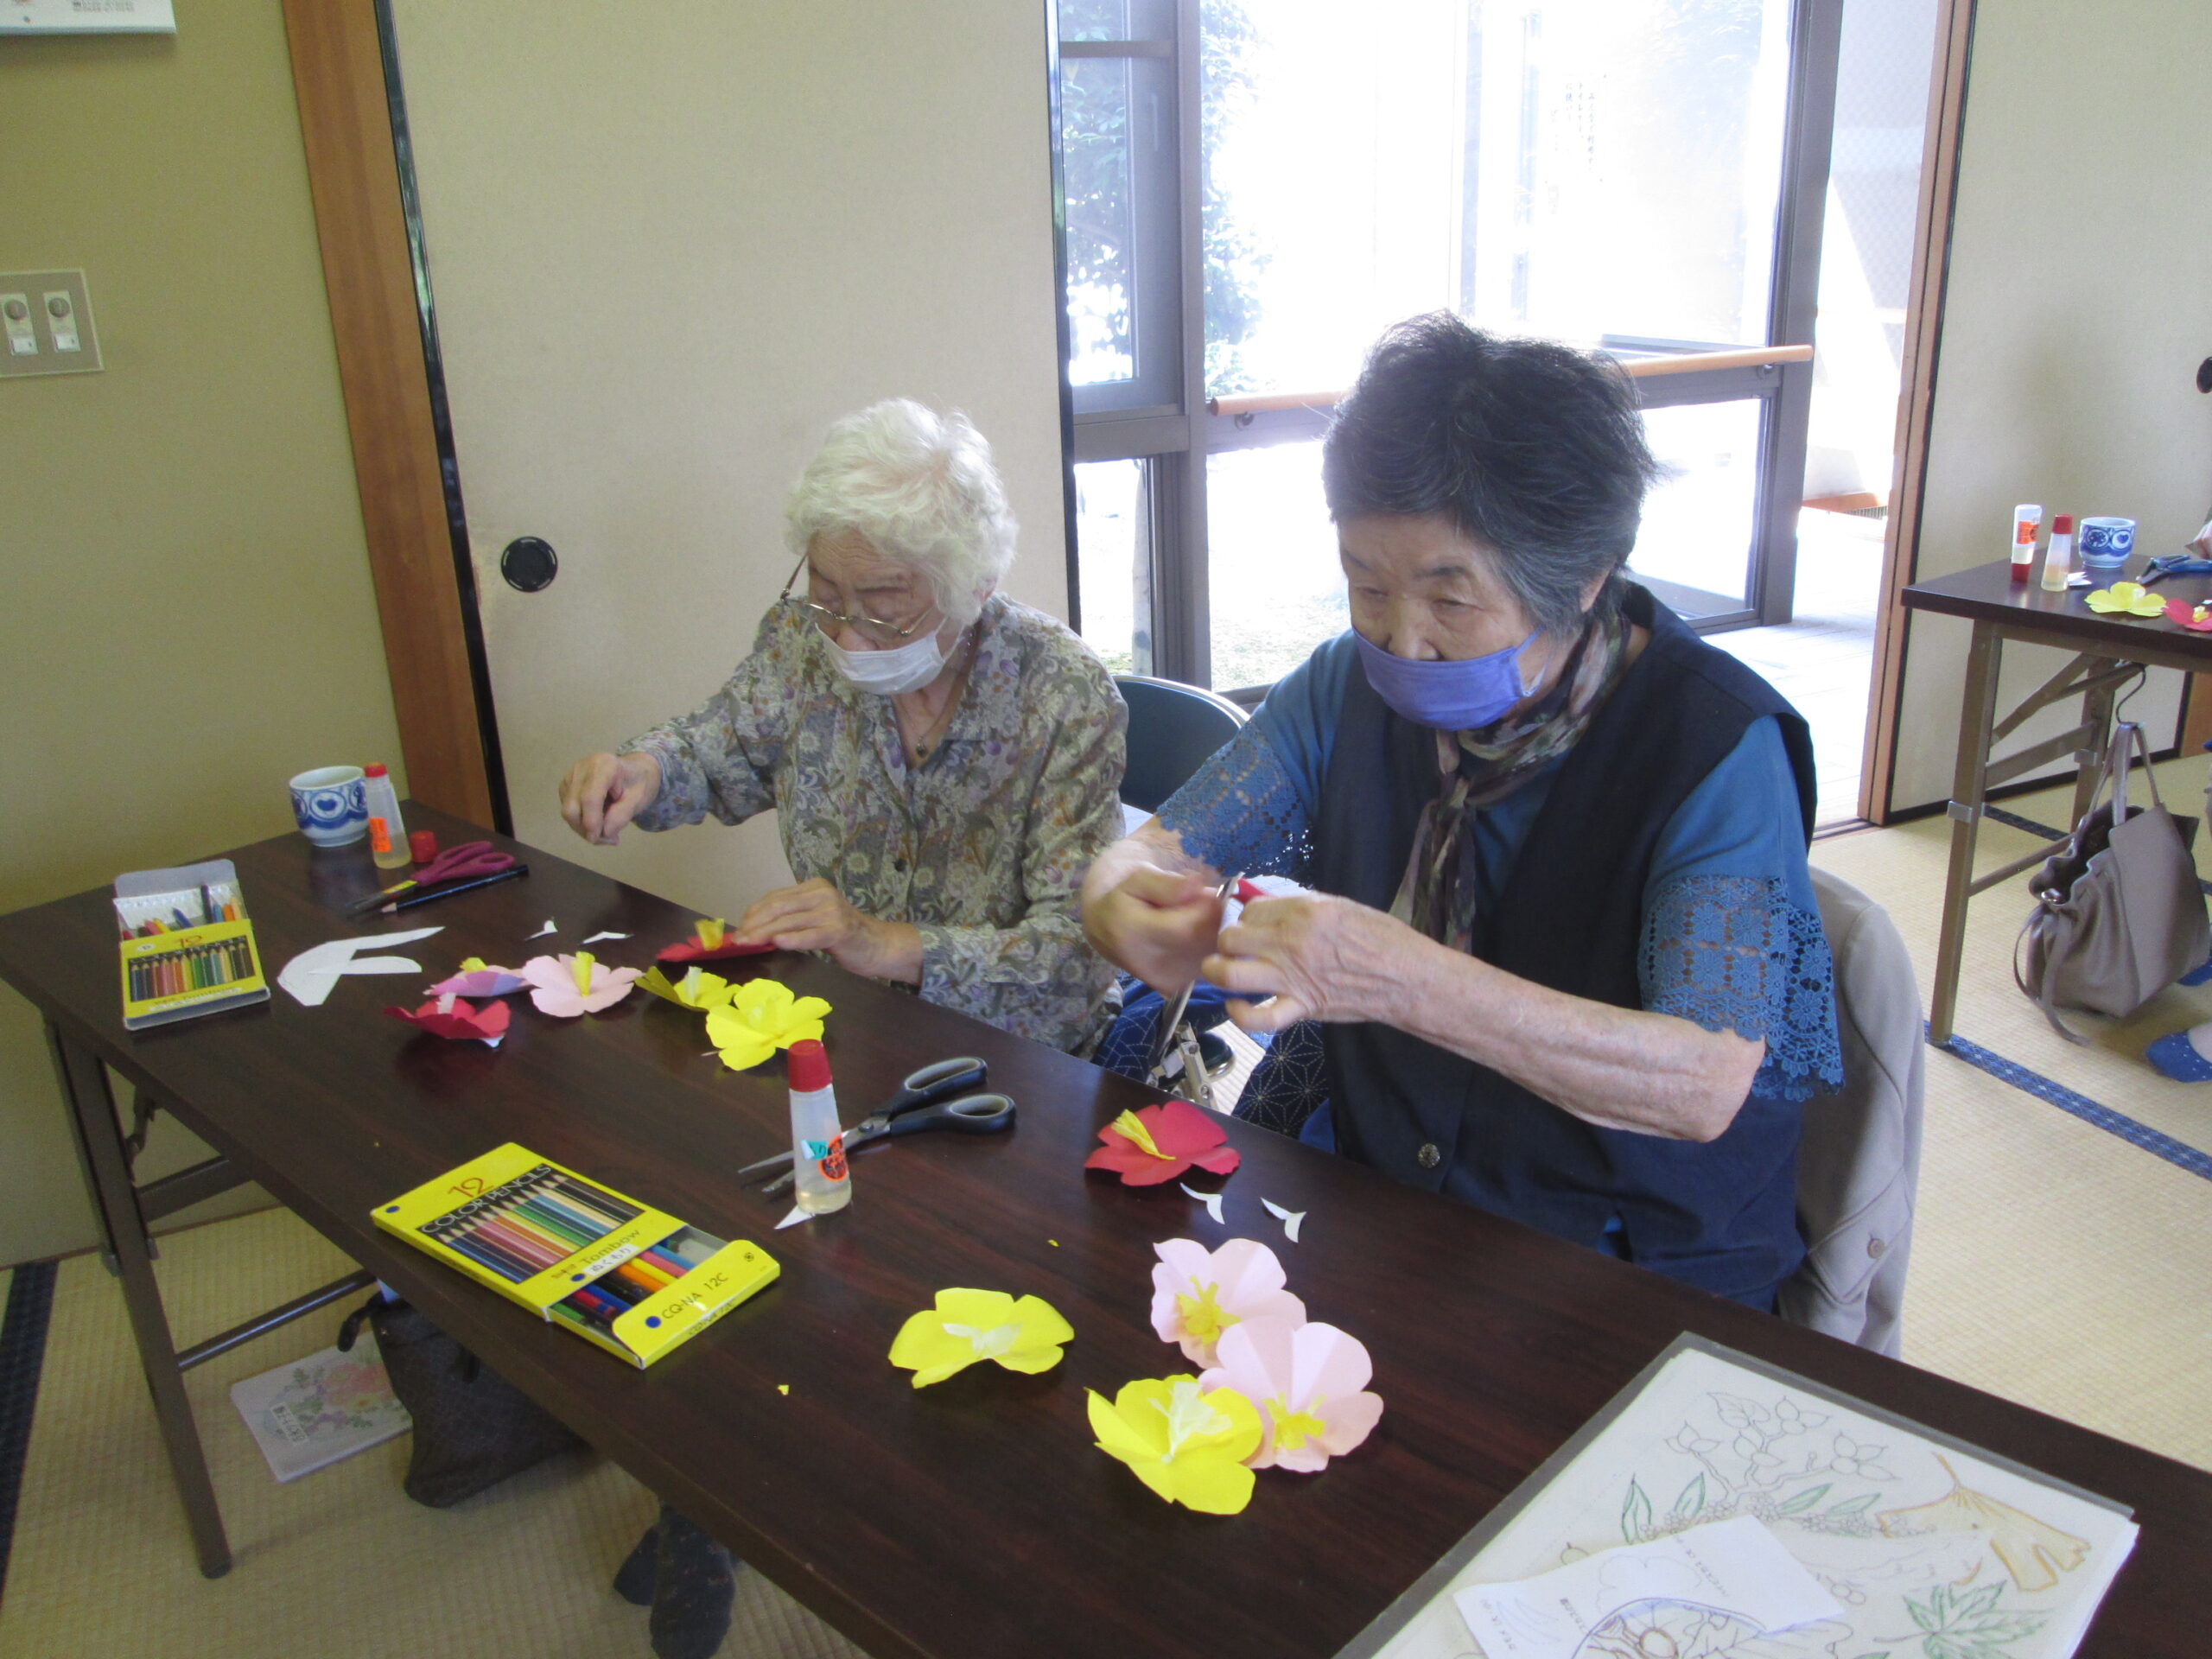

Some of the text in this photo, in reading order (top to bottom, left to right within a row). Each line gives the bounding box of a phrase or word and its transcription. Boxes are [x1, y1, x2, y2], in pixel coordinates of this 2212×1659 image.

[422, 1164, 551, 1233] COLOR PENCILS
[448, 1177, 494, 1198] 12
[581, 1230, 640, 1264] Tombow
[703, 1272, 728, 1291] 12C
